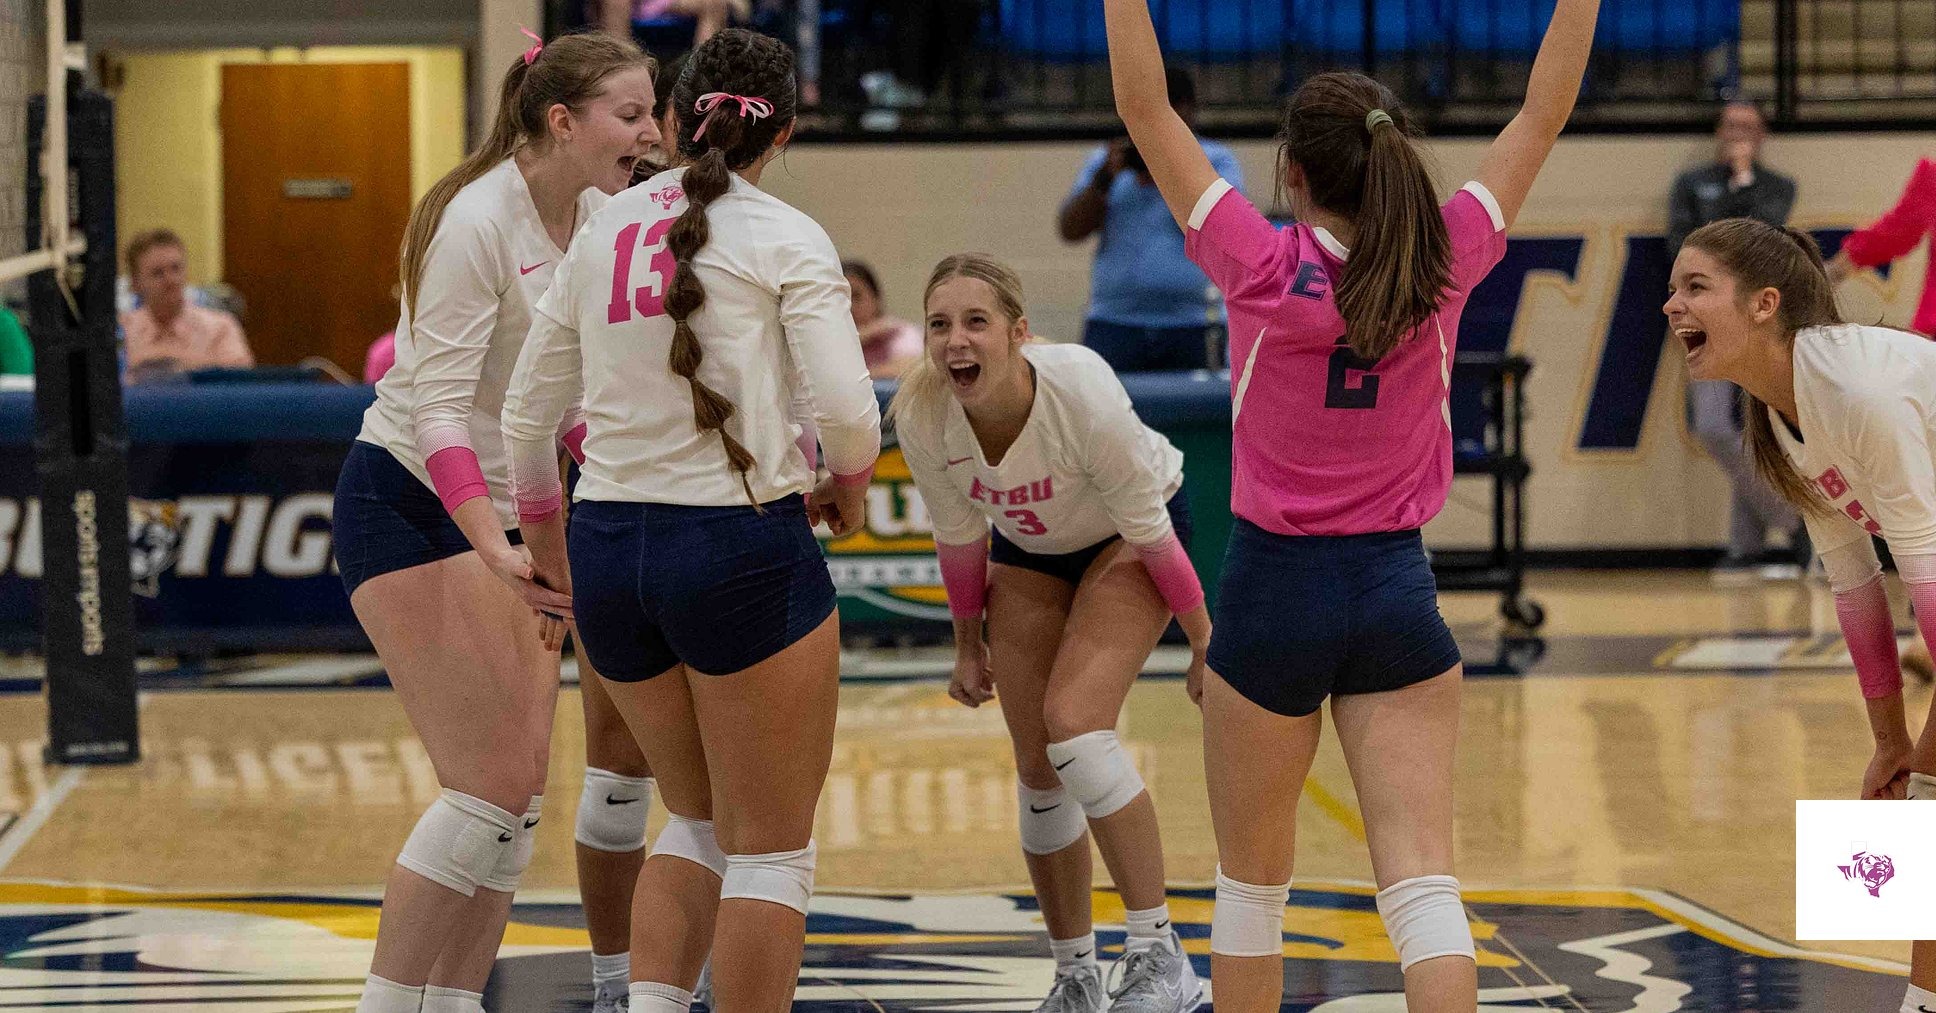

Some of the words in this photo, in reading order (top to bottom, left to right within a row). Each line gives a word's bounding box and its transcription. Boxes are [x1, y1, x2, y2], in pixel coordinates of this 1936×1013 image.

[970, 475, 1054, 505] ETBU
[175, 493, 339, 578] TIG
[1004, 509, 1047, 536] 3
